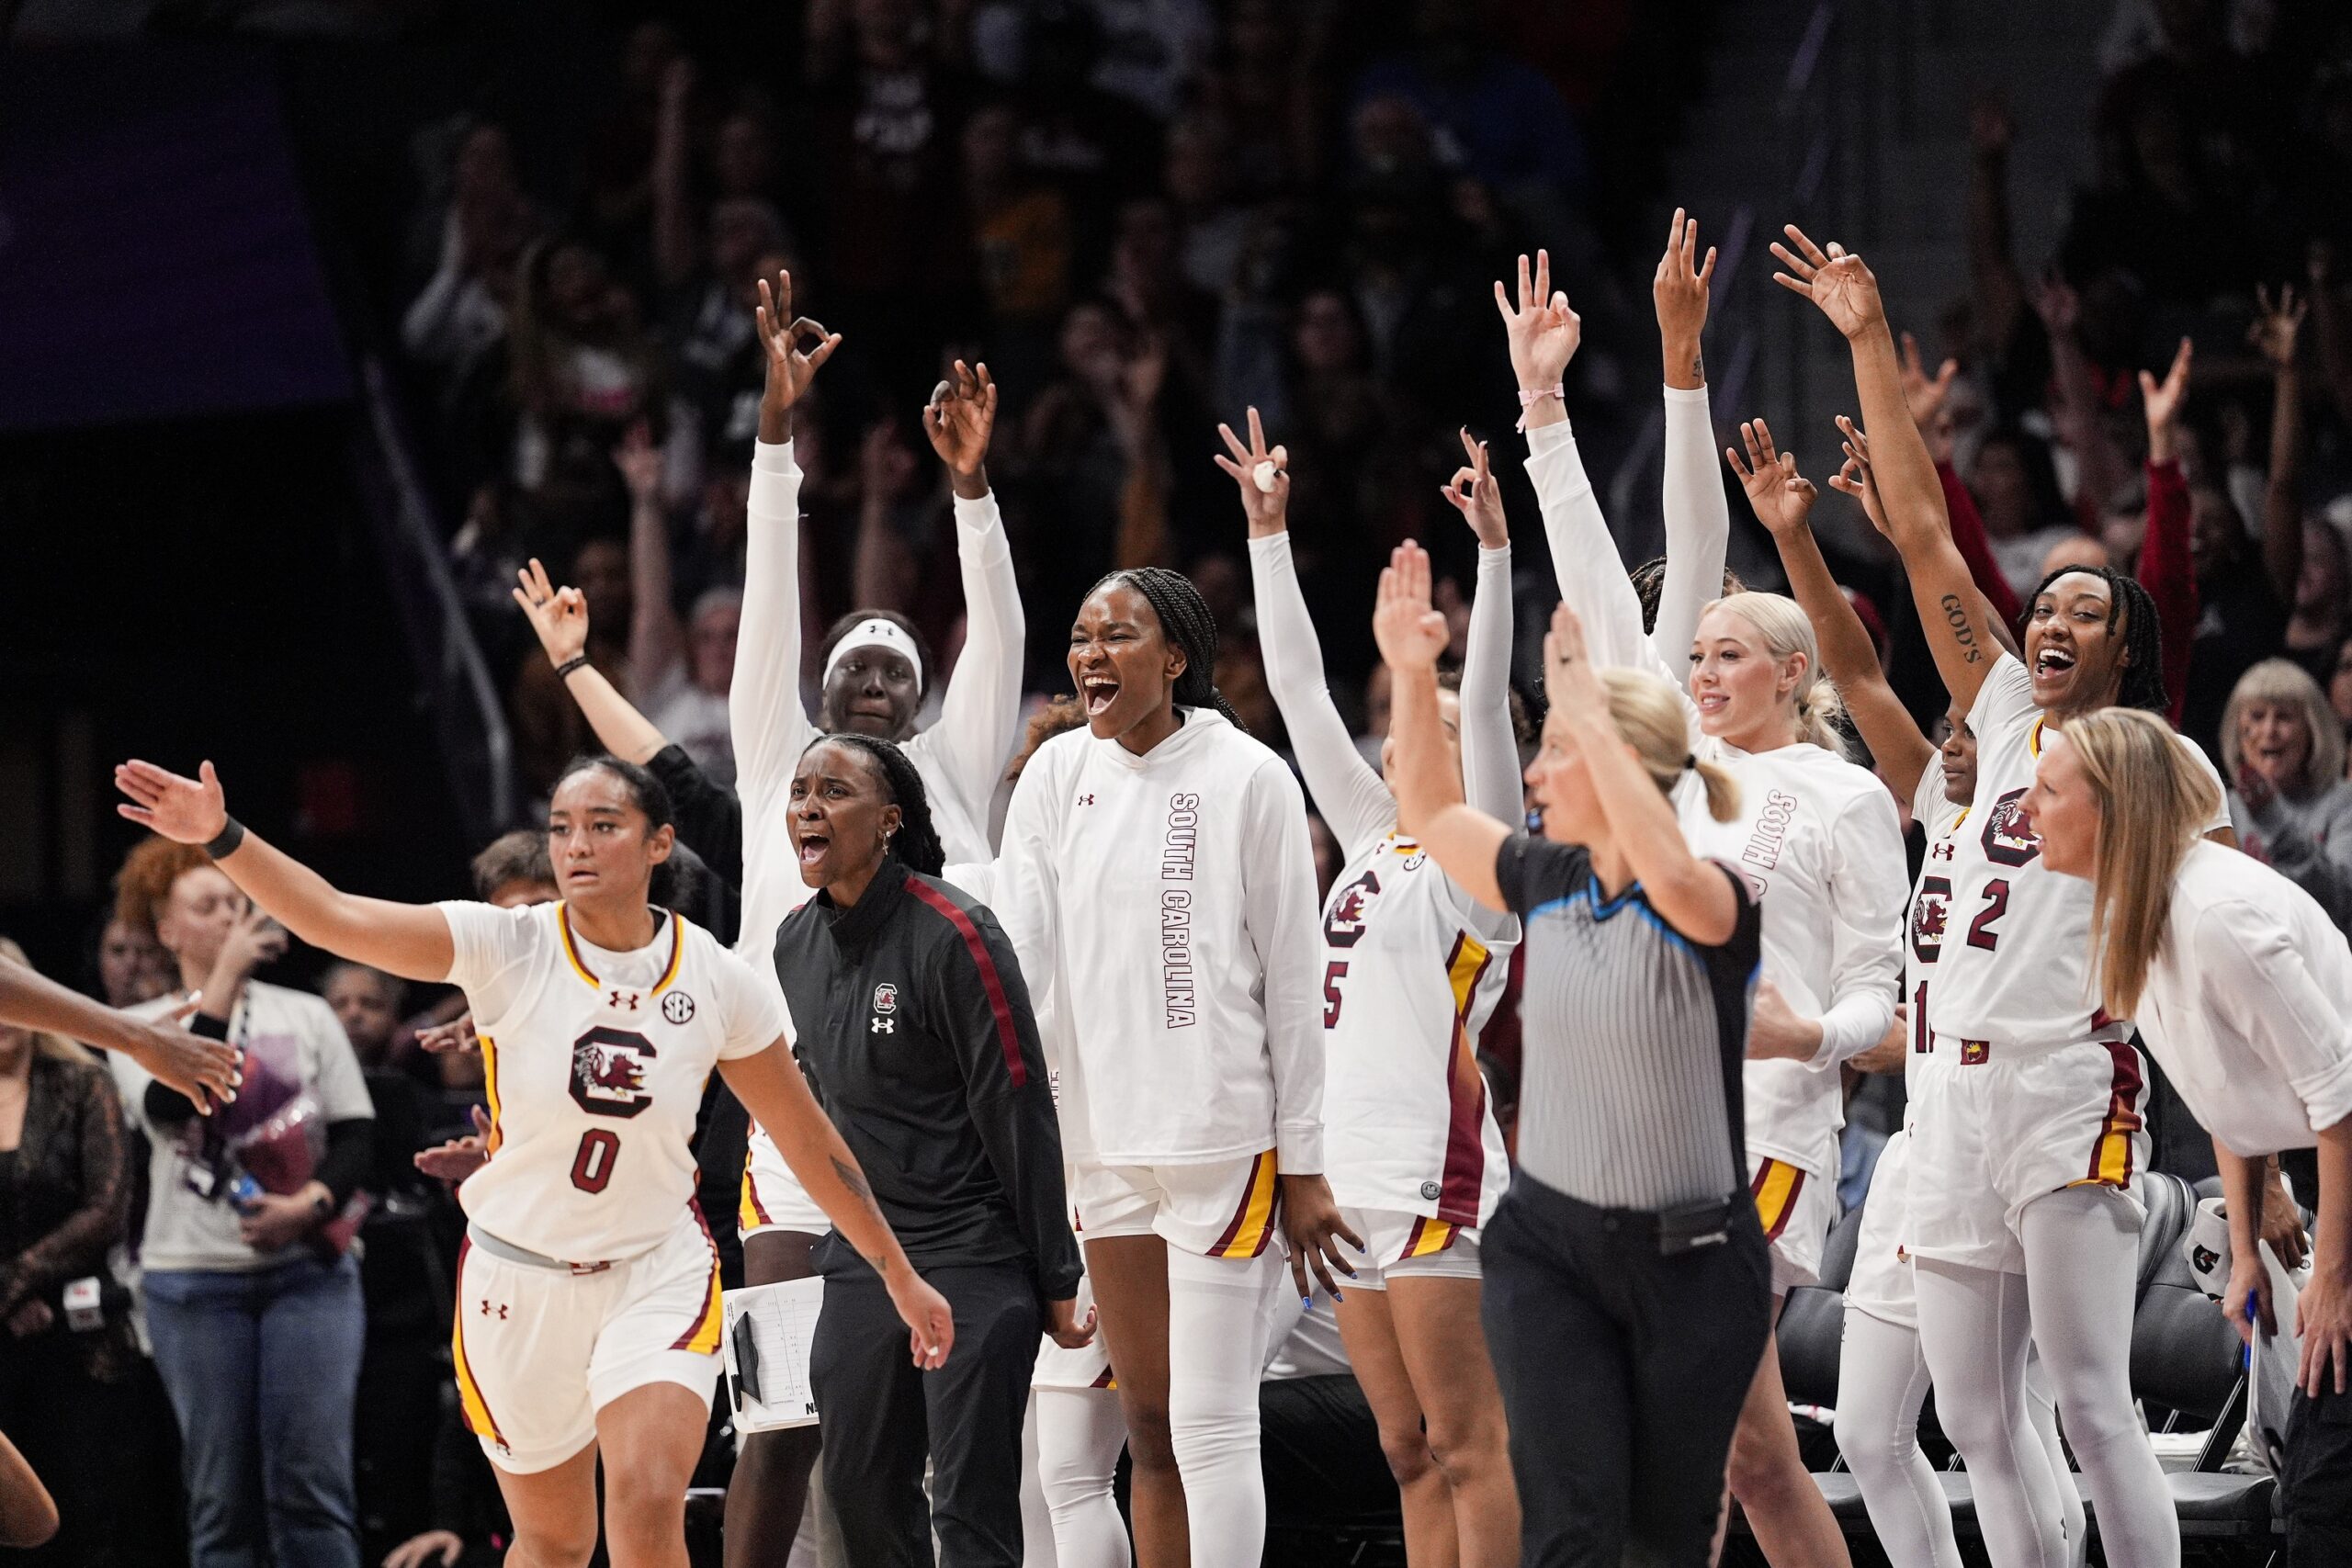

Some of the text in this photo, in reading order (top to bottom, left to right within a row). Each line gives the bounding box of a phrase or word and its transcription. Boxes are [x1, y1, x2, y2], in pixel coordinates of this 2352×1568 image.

[1941, 594, 1982, 663] GOD'S
[1742, 789, 1797, 870] SOUTH
[1161, 794, 1199, 1029] SOUTH CAROLINA
[1966, 878, 2010, 952] 2
[662, 992, 695, 1024] SEC
[1324, 961, 1349, 1029] 5
[568, 1025, 657, 1119] C
[570, 1128, 621, 1195] 0
